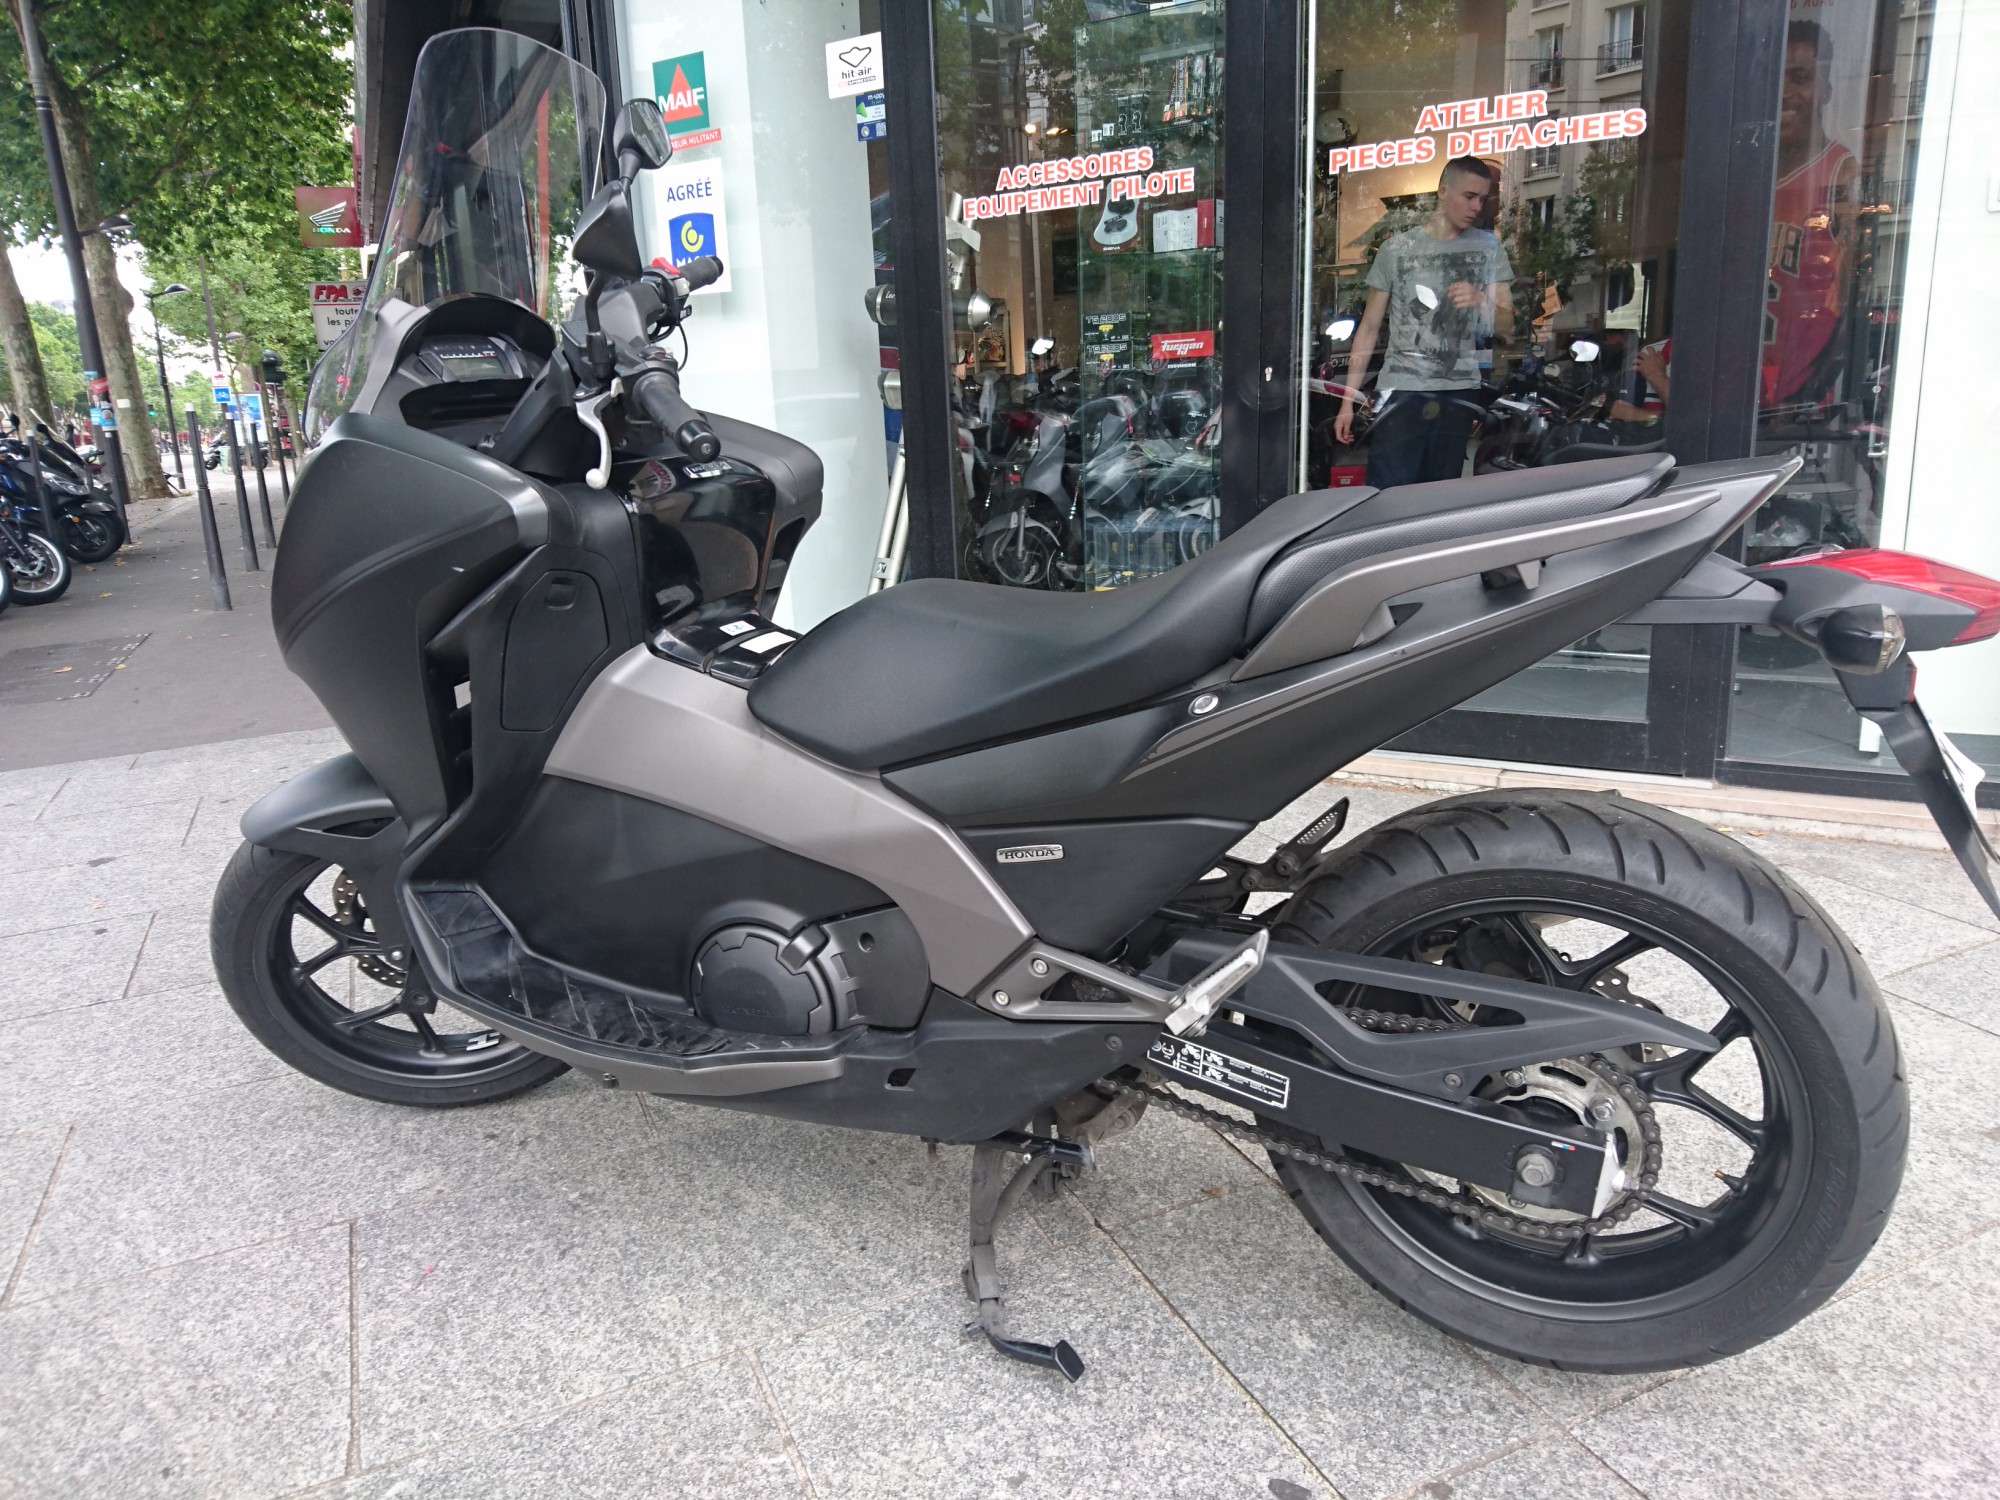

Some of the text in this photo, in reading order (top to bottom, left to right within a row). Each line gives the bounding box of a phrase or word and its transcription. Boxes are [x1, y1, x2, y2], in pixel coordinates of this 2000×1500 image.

[658, 87, 705, 112] MAIF
[1415, 90, 1548, 133] ATELIER
[1329, 108, 1647, 174] PIECES DETACHEES
[995, 146, 1153, 191] ACCESSOIRES
[667, 177, 712, 202] AGRÉÉ
[962, 167, 1195, 220] EQUIPEMENT PILOTE
[312, 227, 351, 235] HONDA
[314, 285, 348, 302] FPA
[327, 317, 341, 326] les
[1004, 849, 1055, 859] HONDA
